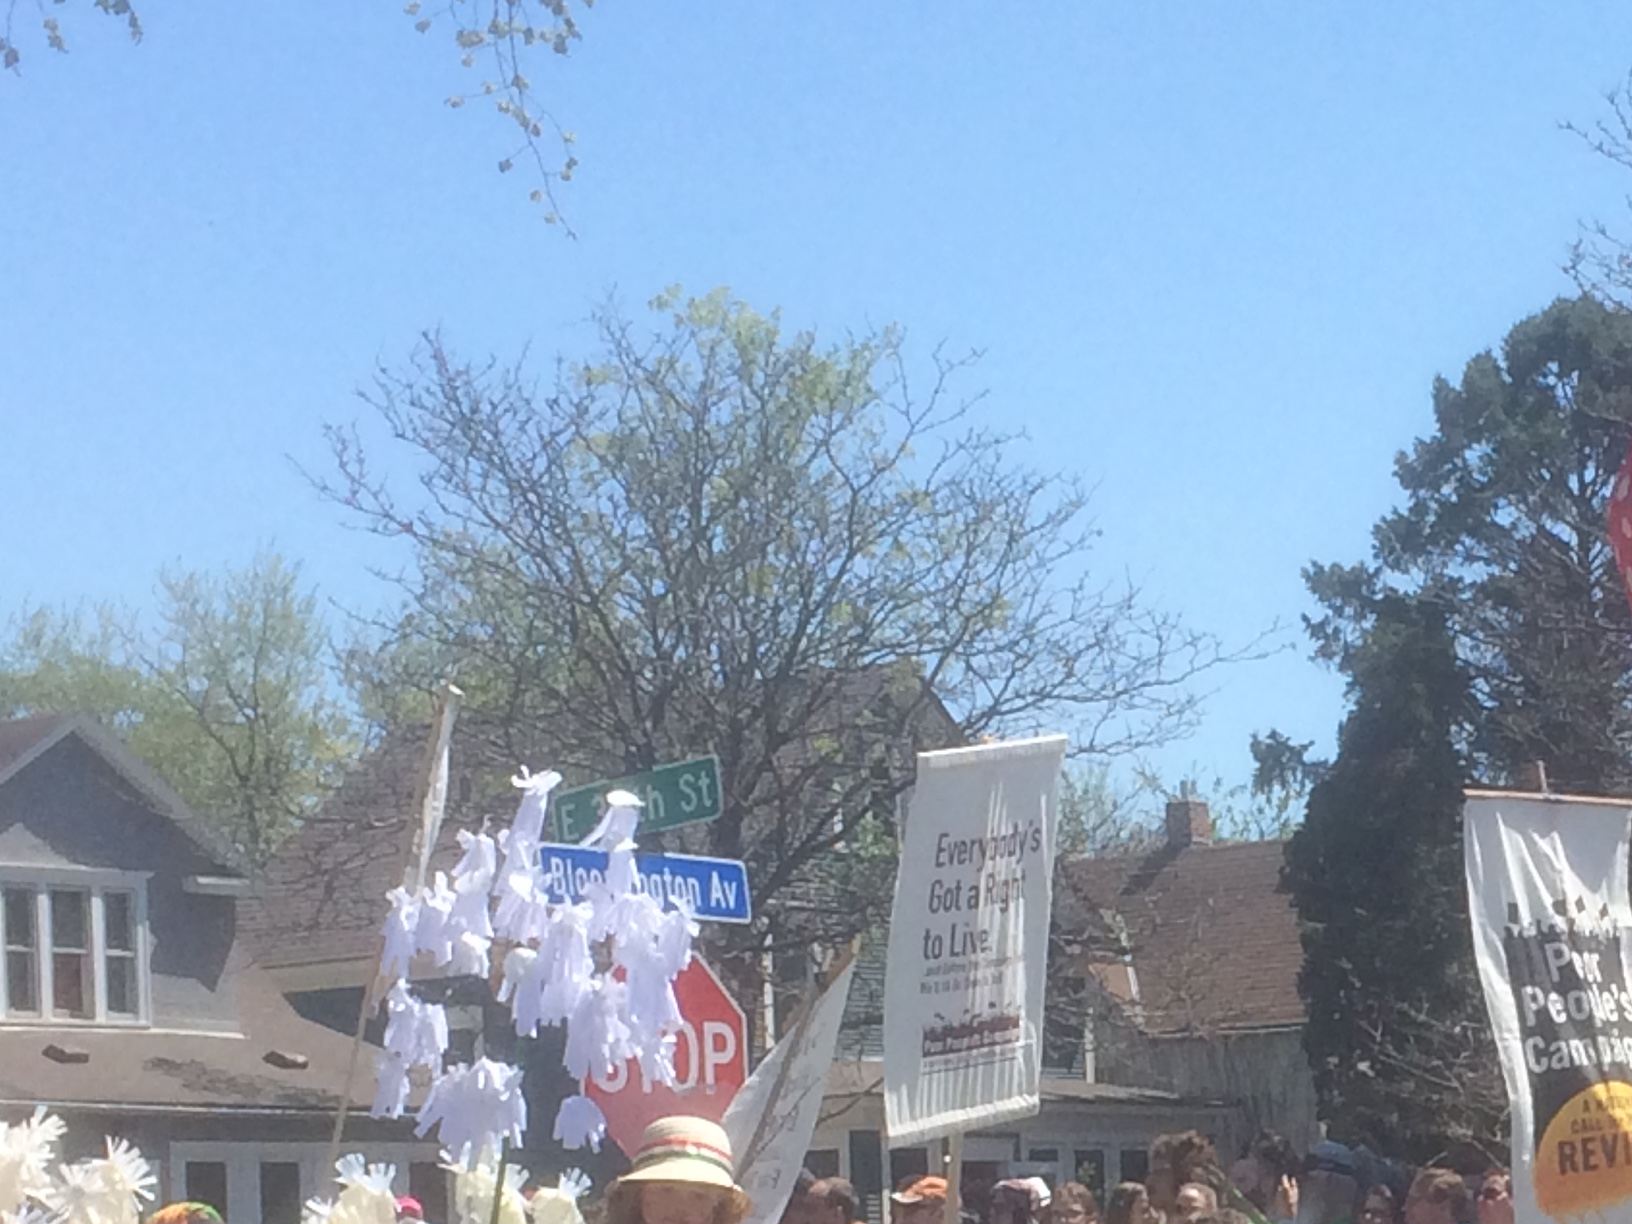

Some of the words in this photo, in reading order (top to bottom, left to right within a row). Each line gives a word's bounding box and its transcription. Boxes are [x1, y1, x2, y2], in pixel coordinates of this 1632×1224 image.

[561, 804, 579, 841] E
[679, 771, 714, 813] St
[934, 819, 1042, 873] Everybody's
[551, 857, 701, 911] Bloongton
[710, 870, 738, 911] Av
[928, 879, 962, 914] Got
[966, 884, 979, 910] a
[923, 928, 943, 960] to
